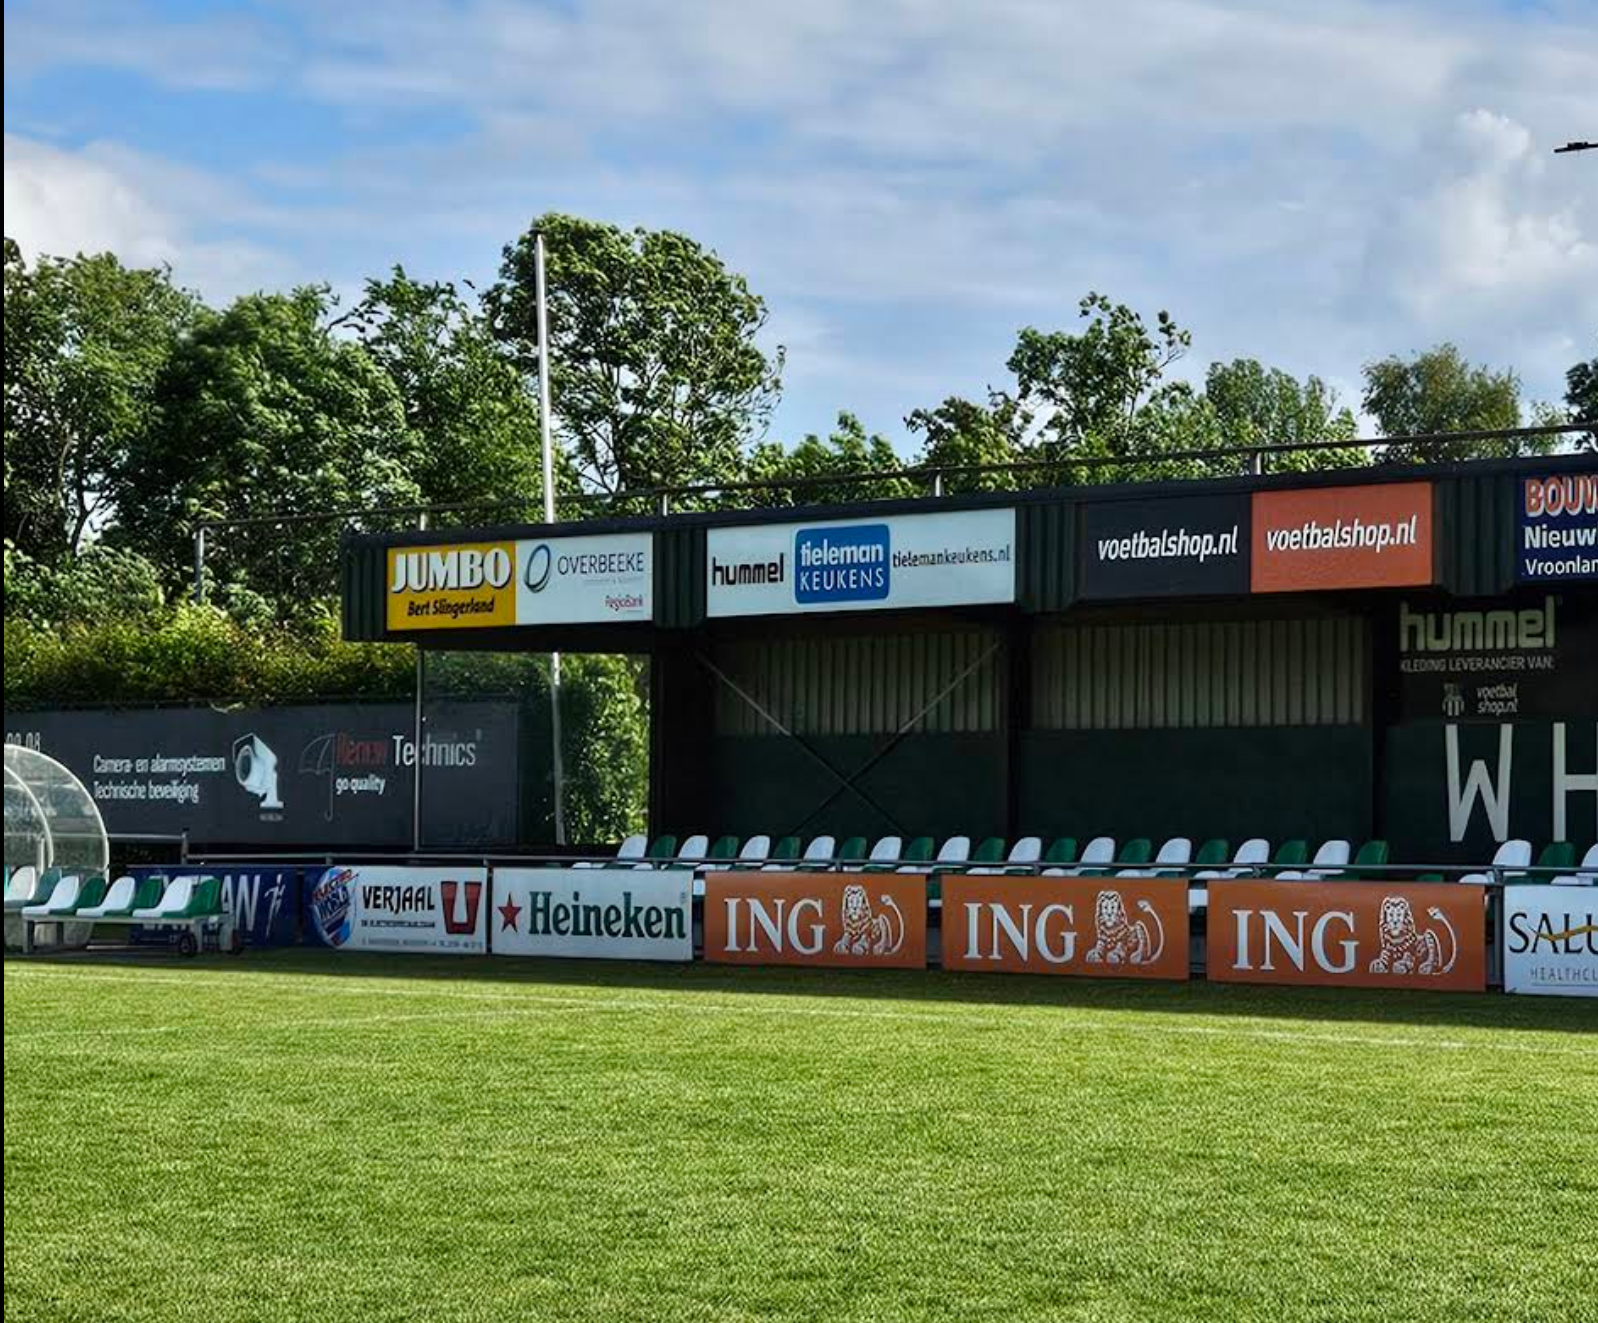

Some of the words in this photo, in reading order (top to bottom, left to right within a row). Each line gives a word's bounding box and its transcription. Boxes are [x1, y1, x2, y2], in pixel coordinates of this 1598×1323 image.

[1097, 525, 1238, 562] voetbalshop.nl
[1267, 515, 1417, 552] voetbalshop.nl
[557, 552, 645, 575] OVERBEEKE
[712, 553, 784, 585] hummel
[800, 539, 884, 567] tieleman
[893, 545, 1010, 568] tielemankeukens.nl
[391, 547, 513, 594] JUMBO
[800, 567, 884, 591] KEUKENS
[407, 600, 430, 616] Bert
[432, 597, 495, 618] Slingerland
[1400, 595, 1555, 651] hummel
[1400, 658, 1446, 672] KLEDING
[1449, 656, 1525, 672] LEVERANCIER
[392, 732, 476, 766] Tehnics
[93, 780, 146, 799] Technische
[363, 886, 435, 915] VERJAAL
[528, 891, 686, 939] Heineken
[723, 898, 826, 955] ING
[963, 903, 1077, 963] ING
[1232, 909, 1360, 973] ING
